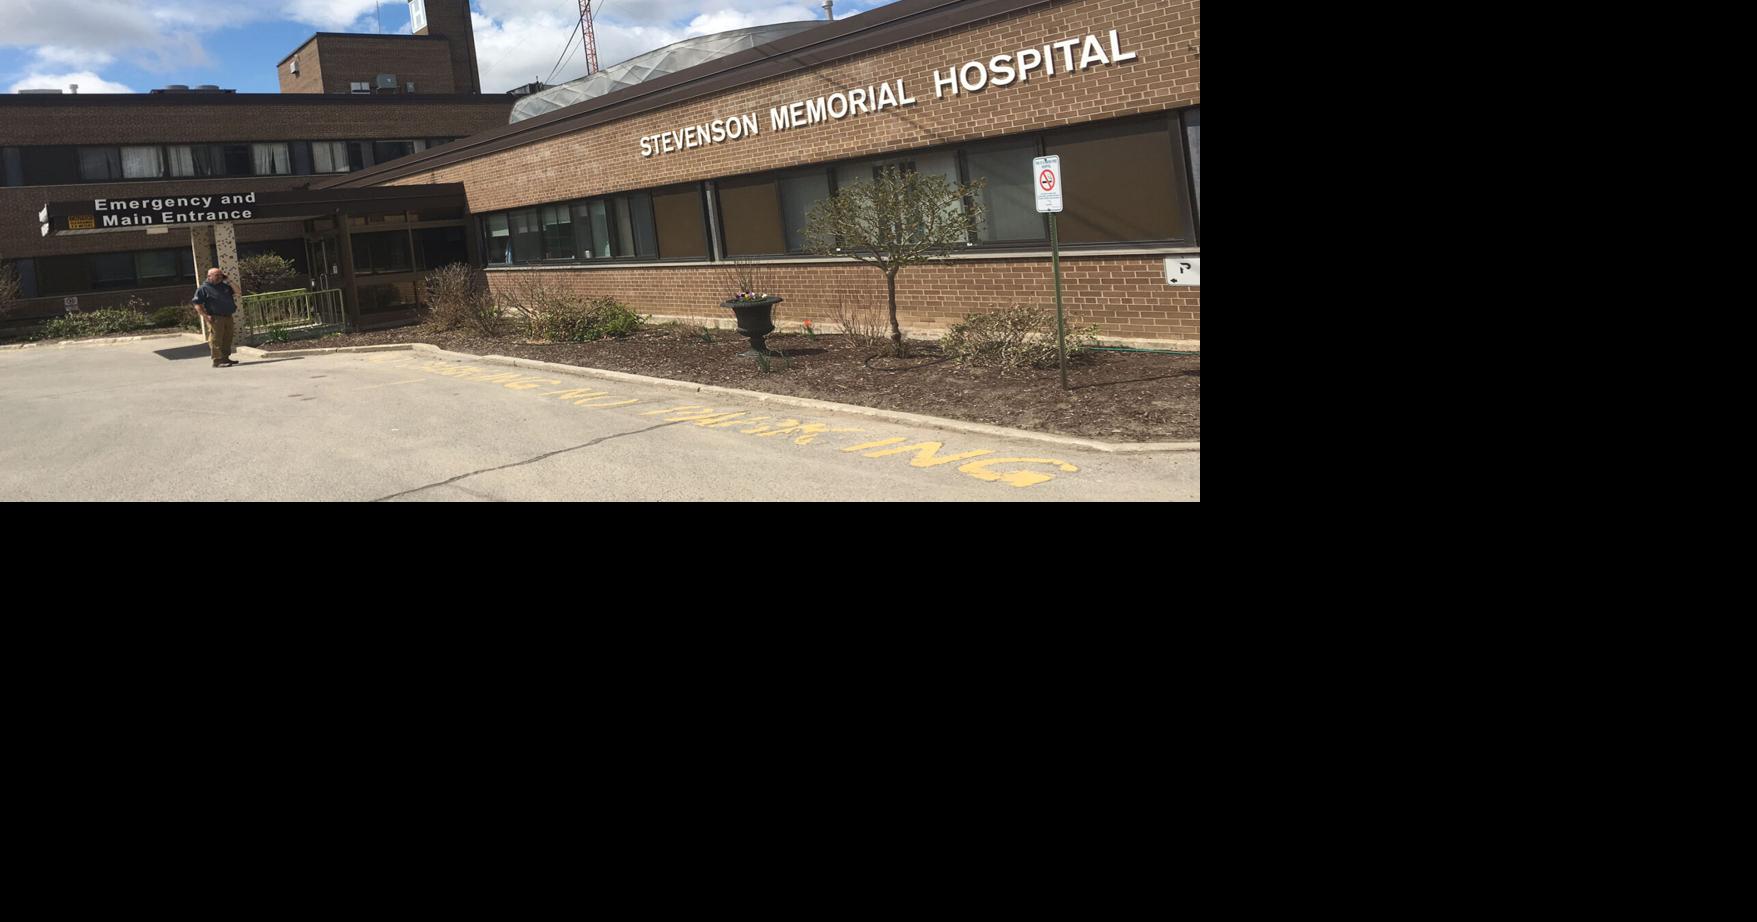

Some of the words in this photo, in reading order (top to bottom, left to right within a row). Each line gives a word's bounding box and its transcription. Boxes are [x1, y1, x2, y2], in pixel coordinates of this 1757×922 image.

[412, 0, 426, 29] H
[639, 112, 759, 158] STEVENSON
[770, 79, 916, 132] MEMORIAL
[933, 29, 1137, 98] HOSPITAL
[95, 196, 212, 211] Emergency
[221, 192, 255, 205] and
[102, 213, 152, 227] Main
[162, 209, 252, 223] Entrance
[540, 387, 640, 408] NO
[639, 404, 1079, 488] PARKING
